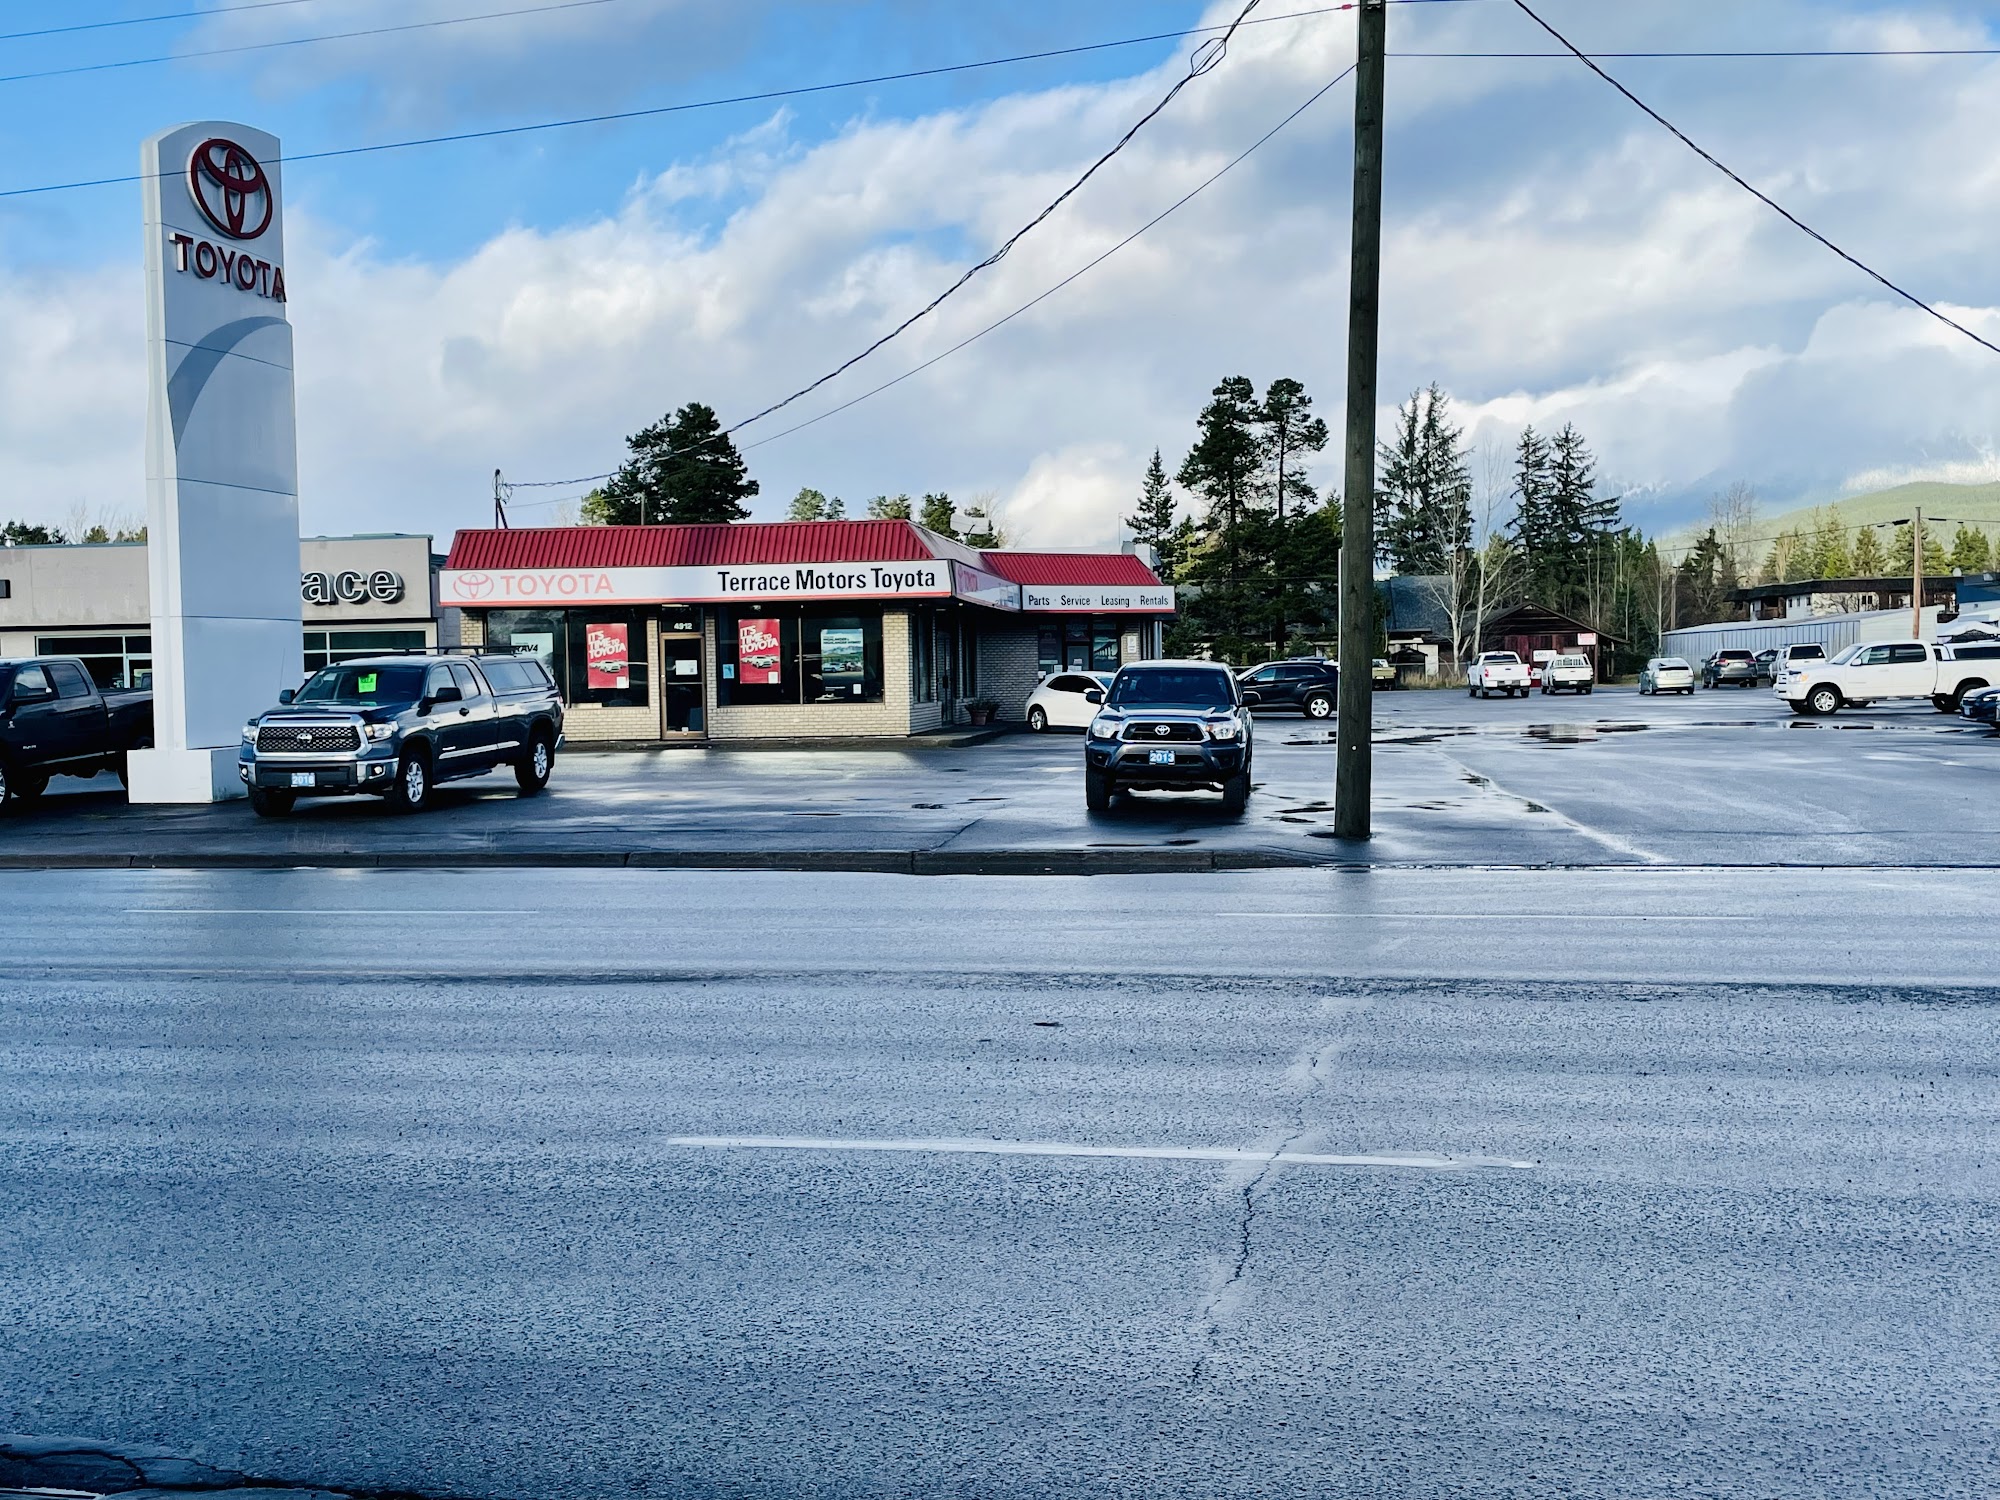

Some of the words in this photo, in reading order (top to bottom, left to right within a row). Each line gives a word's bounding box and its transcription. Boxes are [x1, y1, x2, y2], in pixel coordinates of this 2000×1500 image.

[168, 232, 287, 302] TOYOTA
[501, 573, 614, 595] TOYOTA
[718, 571, 790, 591] Terrace
[796, 569, 867, 590] Motors
[870, 567, 936, 592] Toyota
[1028, 594, 1050, 606] Parts
[1061, 594, 1091, 606] Service
[1101, 594, 1130, 608] Leasing
[1140, 594, 1169, 606] Rentals
[589, 637, 611, 650] TIME
[740, 632, 763, 645] TIME
[740, 637, 779, 654] TOYOTA
[590, 643, 627, 659] TOYOTA
[1150, 753, 1175, 762] 2013
